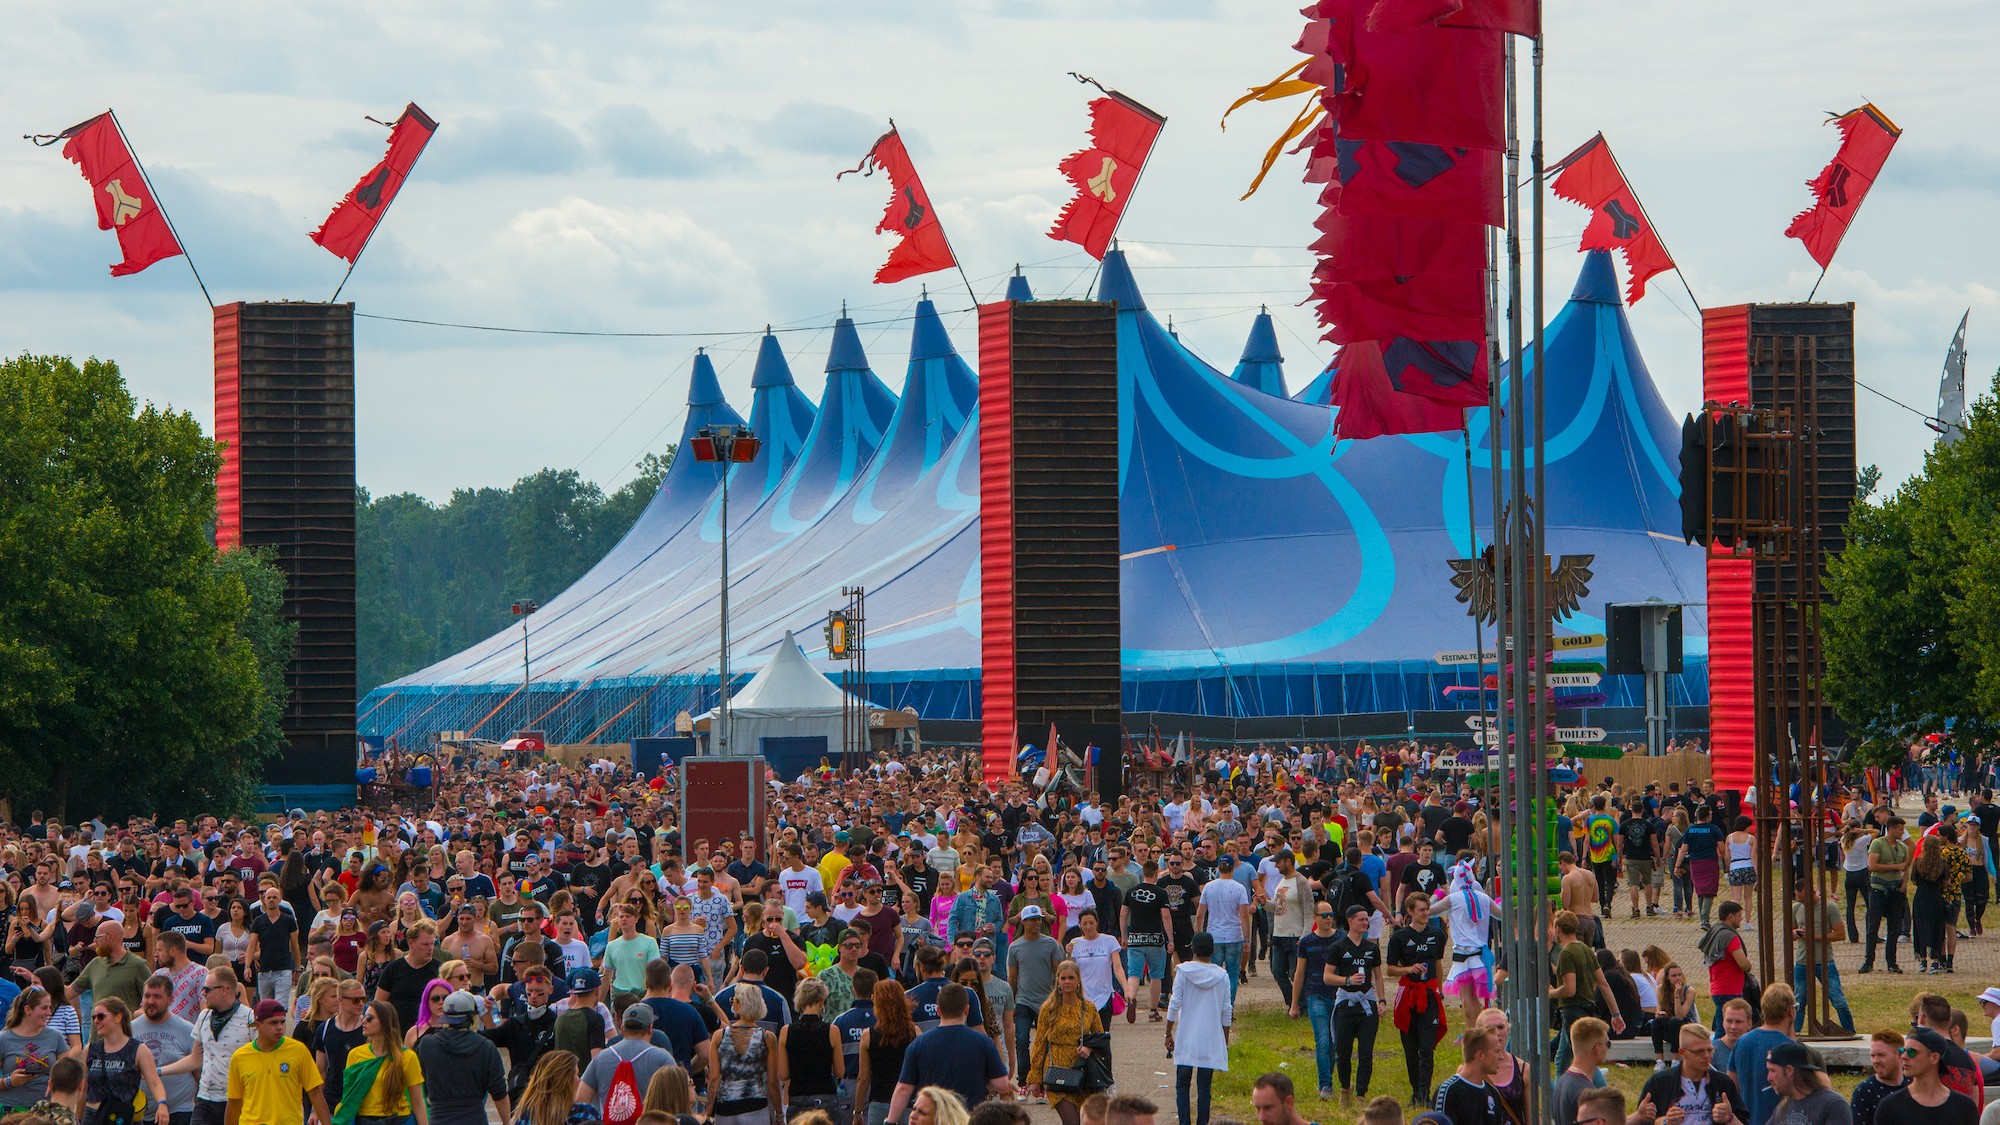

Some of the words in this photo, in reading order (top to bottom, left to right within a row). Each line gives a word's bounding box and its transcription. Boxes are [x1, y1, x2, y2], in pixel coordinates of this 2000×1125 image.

[1561, 636, 1593, 646] GOLD
[1441, 654, 1469, 662] FESTIVAL
[1469, 652, 1497, 660] TEREIN
[1551, 676, 1570, 685] STAY
[1570, 676, 1591, 684] AWAY
[1558, 730, 1599, 739] TOILETS
[1566, 746, 1611, 758] BADHUIS
[1442, 759, 1454, 767] NO
[1416, 944, 1429, 952] AIG
[1351, 958, 1366, 966] AIG
[171, 998, 189, 1014] EBO
